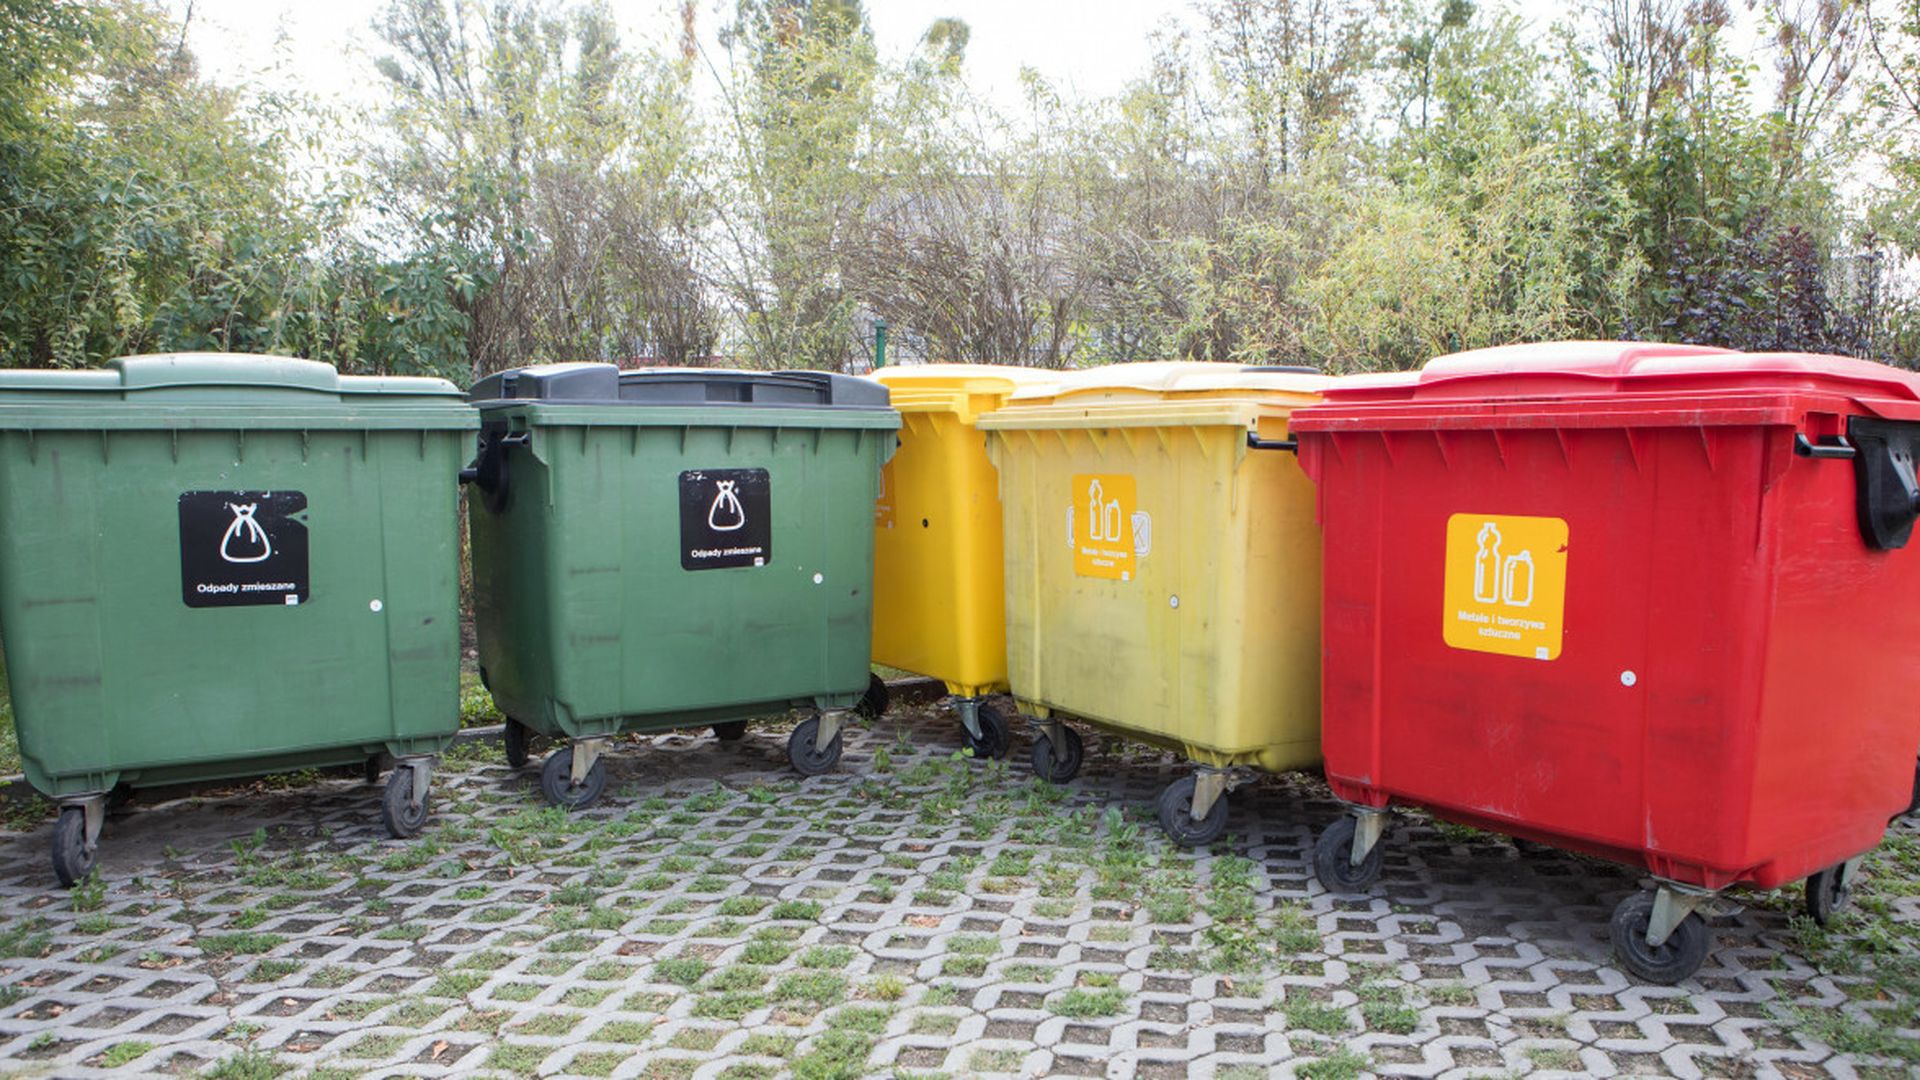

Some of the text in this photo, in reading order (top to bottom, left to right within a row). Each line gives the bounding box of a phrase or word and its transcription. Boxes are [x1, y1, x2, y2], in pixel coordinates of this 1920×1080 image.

[691, 547, 762, 558] Odpady zmieszane
[197, 582, 295, 594] Odpady zmieszane
